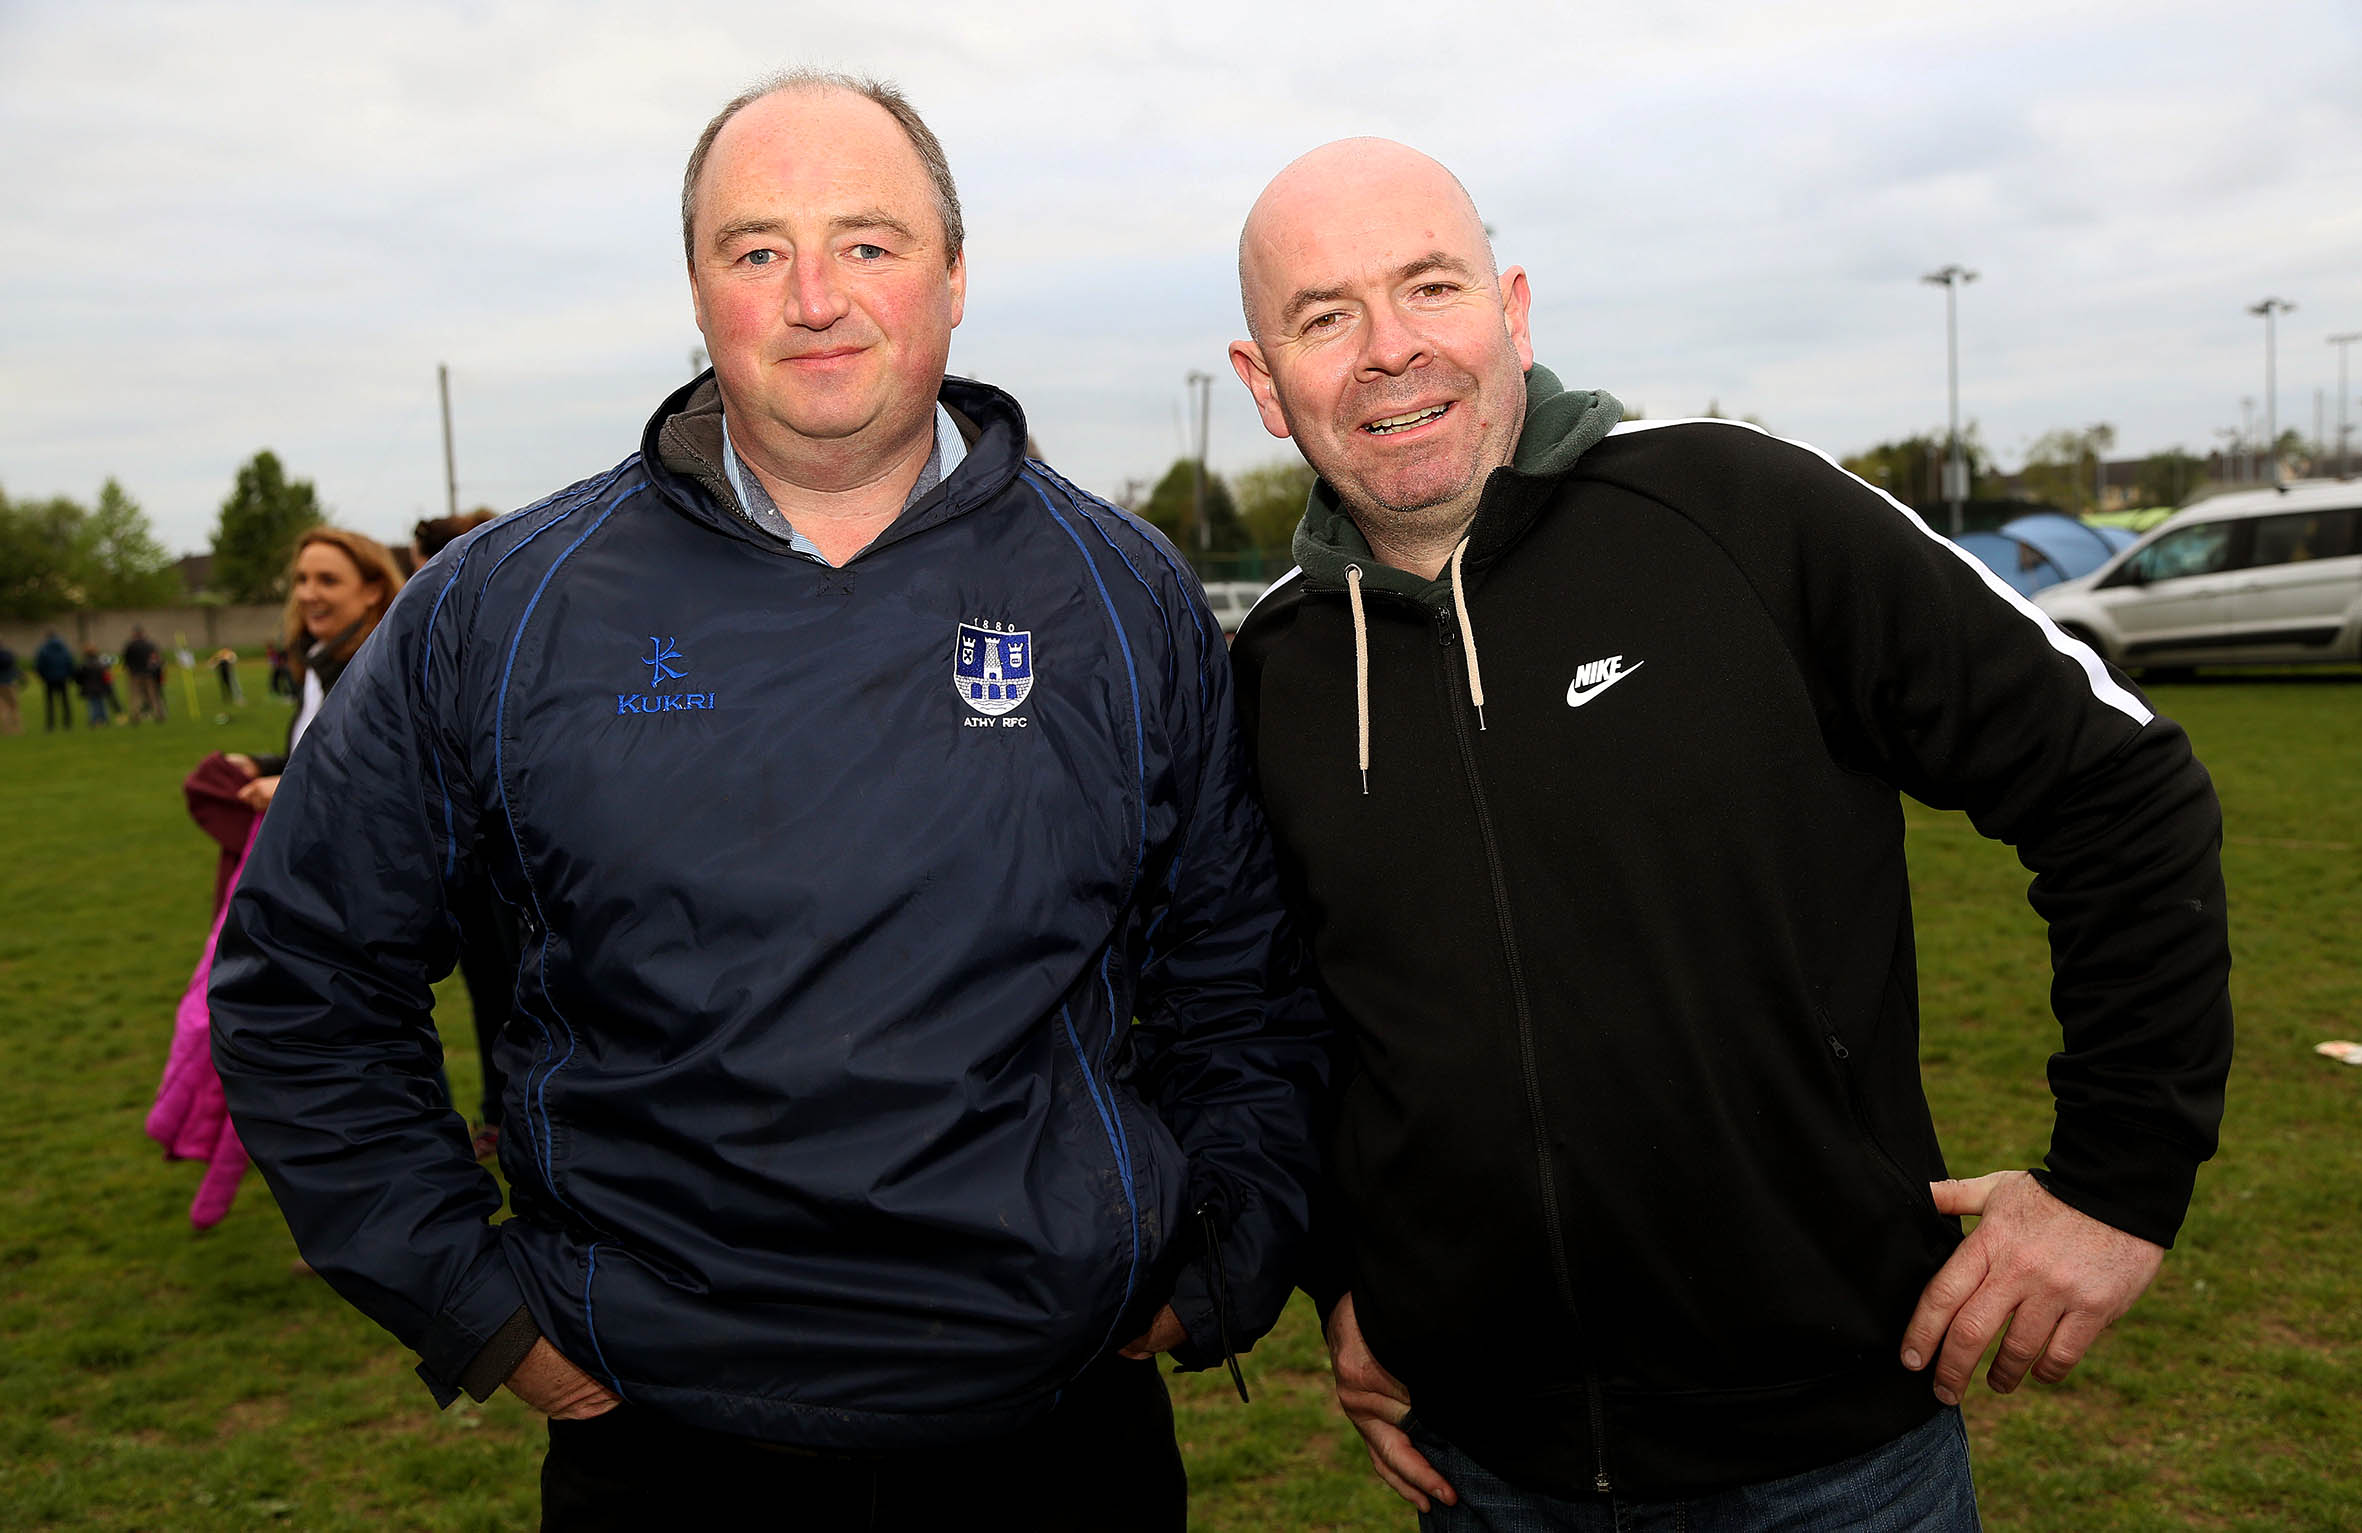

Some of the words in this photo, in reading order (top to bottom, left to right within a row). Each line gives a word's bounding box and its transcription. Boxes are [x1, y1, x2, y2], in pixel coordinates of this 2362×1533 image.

[973, 617, 1015, 633] 1880
[1574, 655, 1623, 689] NIKE
[616, 692, 716, 715] KUKRI
[964, 717, 996, 728] ATHY
[1002, 717, 1028, 728] RFC
